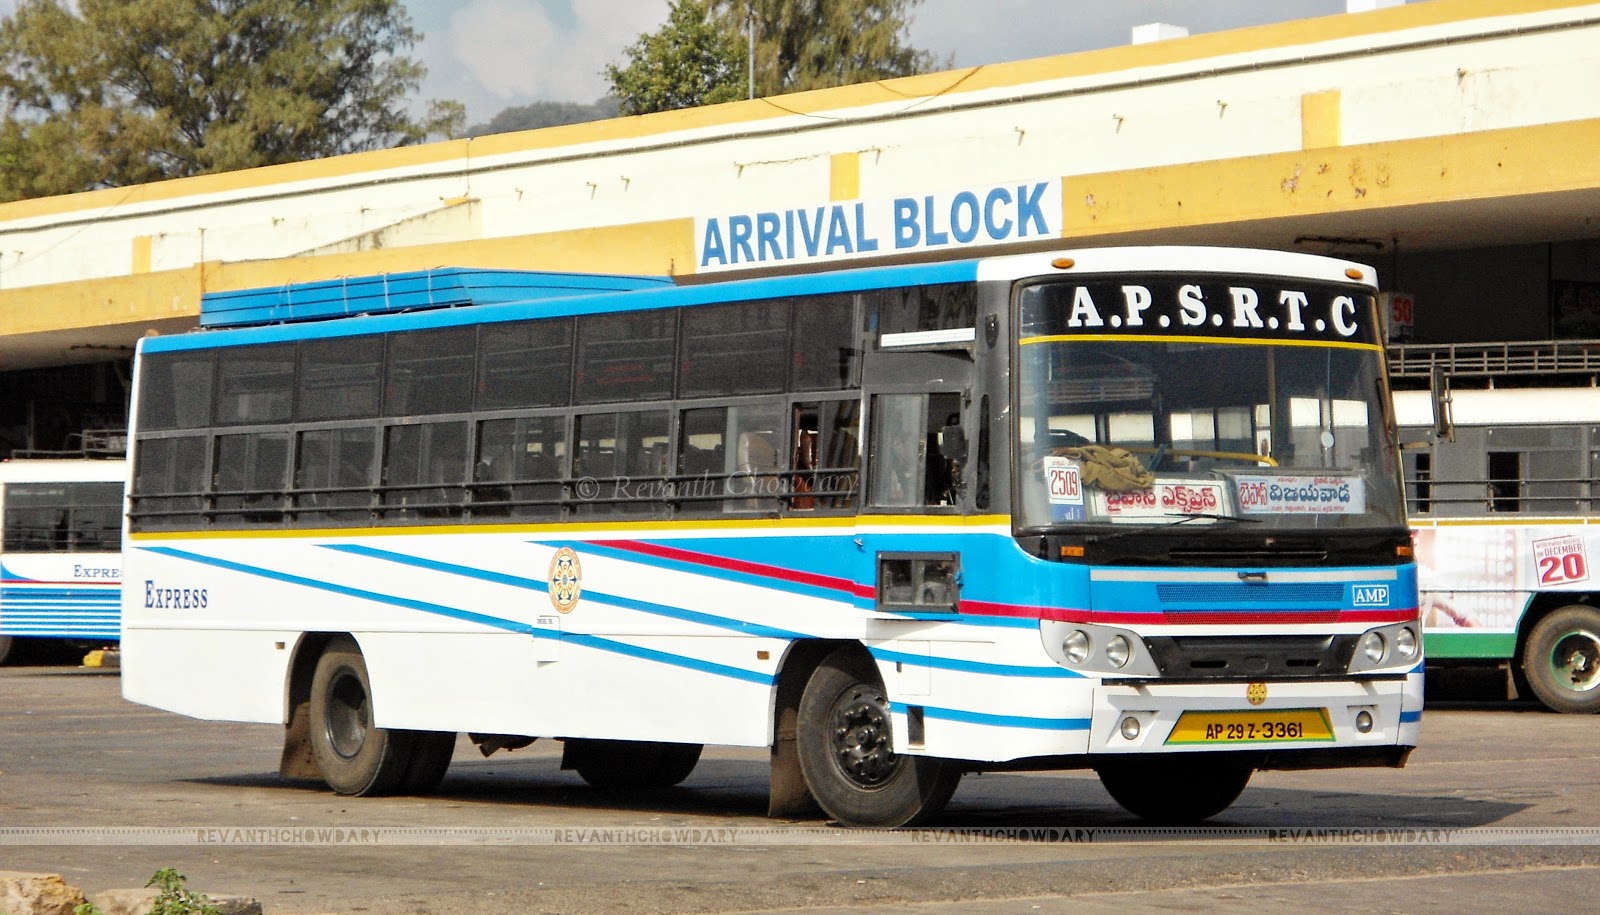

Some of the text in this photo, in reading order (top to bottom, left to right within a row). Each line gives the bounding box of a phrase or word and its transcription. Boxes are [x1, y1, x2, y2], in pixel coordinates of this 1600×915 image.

[701, 181, 1050, 268] ARRIVAL BLOCK
[1050, 470, 1079, 496] 2509
[1269, 484, 1351, 503] విజయవాడ
[1544, 543, 1583, 557] DECEMBER
[1540, 552, 1586, 584] 20
[1356, 587, 1388, 604] AMP
[1206, 724, 1224, 740] AP
[1228, 724, 1244, 740] 29
